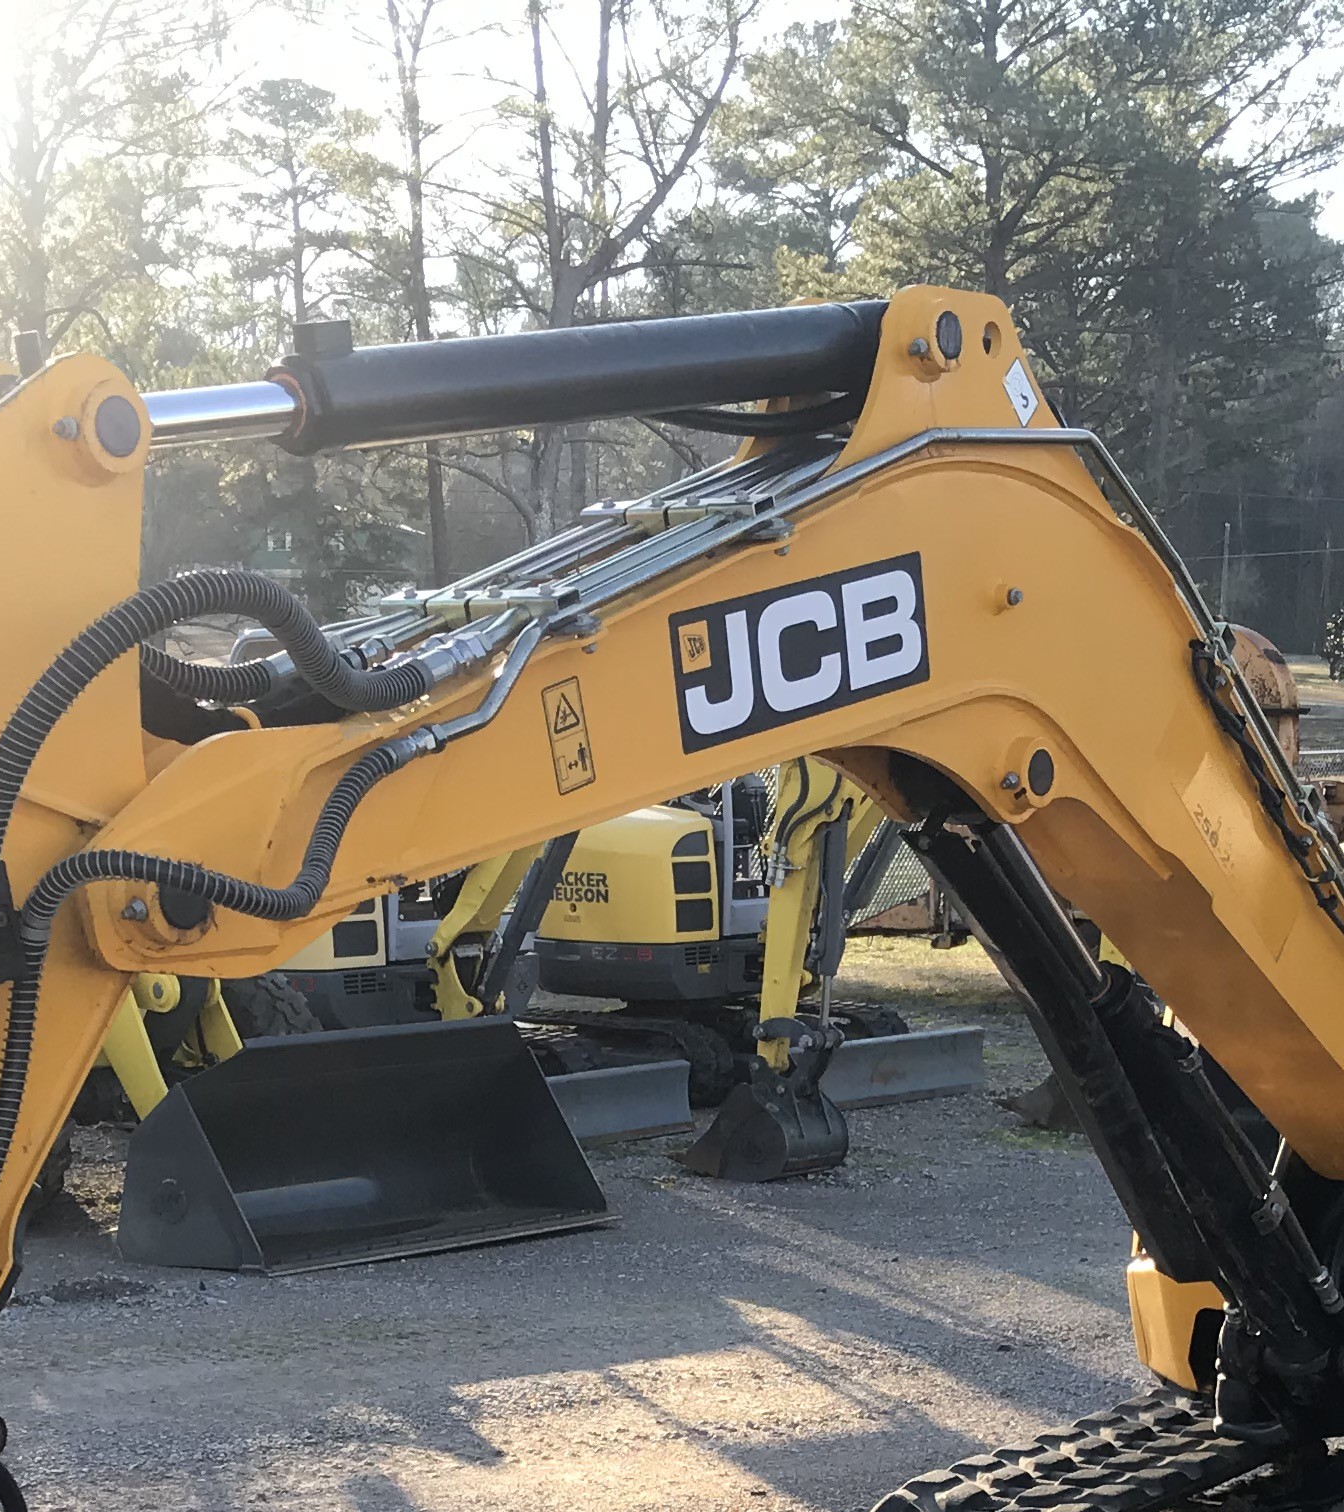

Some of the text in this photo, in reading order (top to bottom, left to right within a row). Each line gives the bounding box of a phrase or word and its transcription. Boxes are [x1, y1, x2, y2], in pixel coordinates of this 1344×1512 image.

[685, 570, 922, 735] JCB
[561, 871, 608, 888] CKER
[552, 886, 609, 904] EUSON
